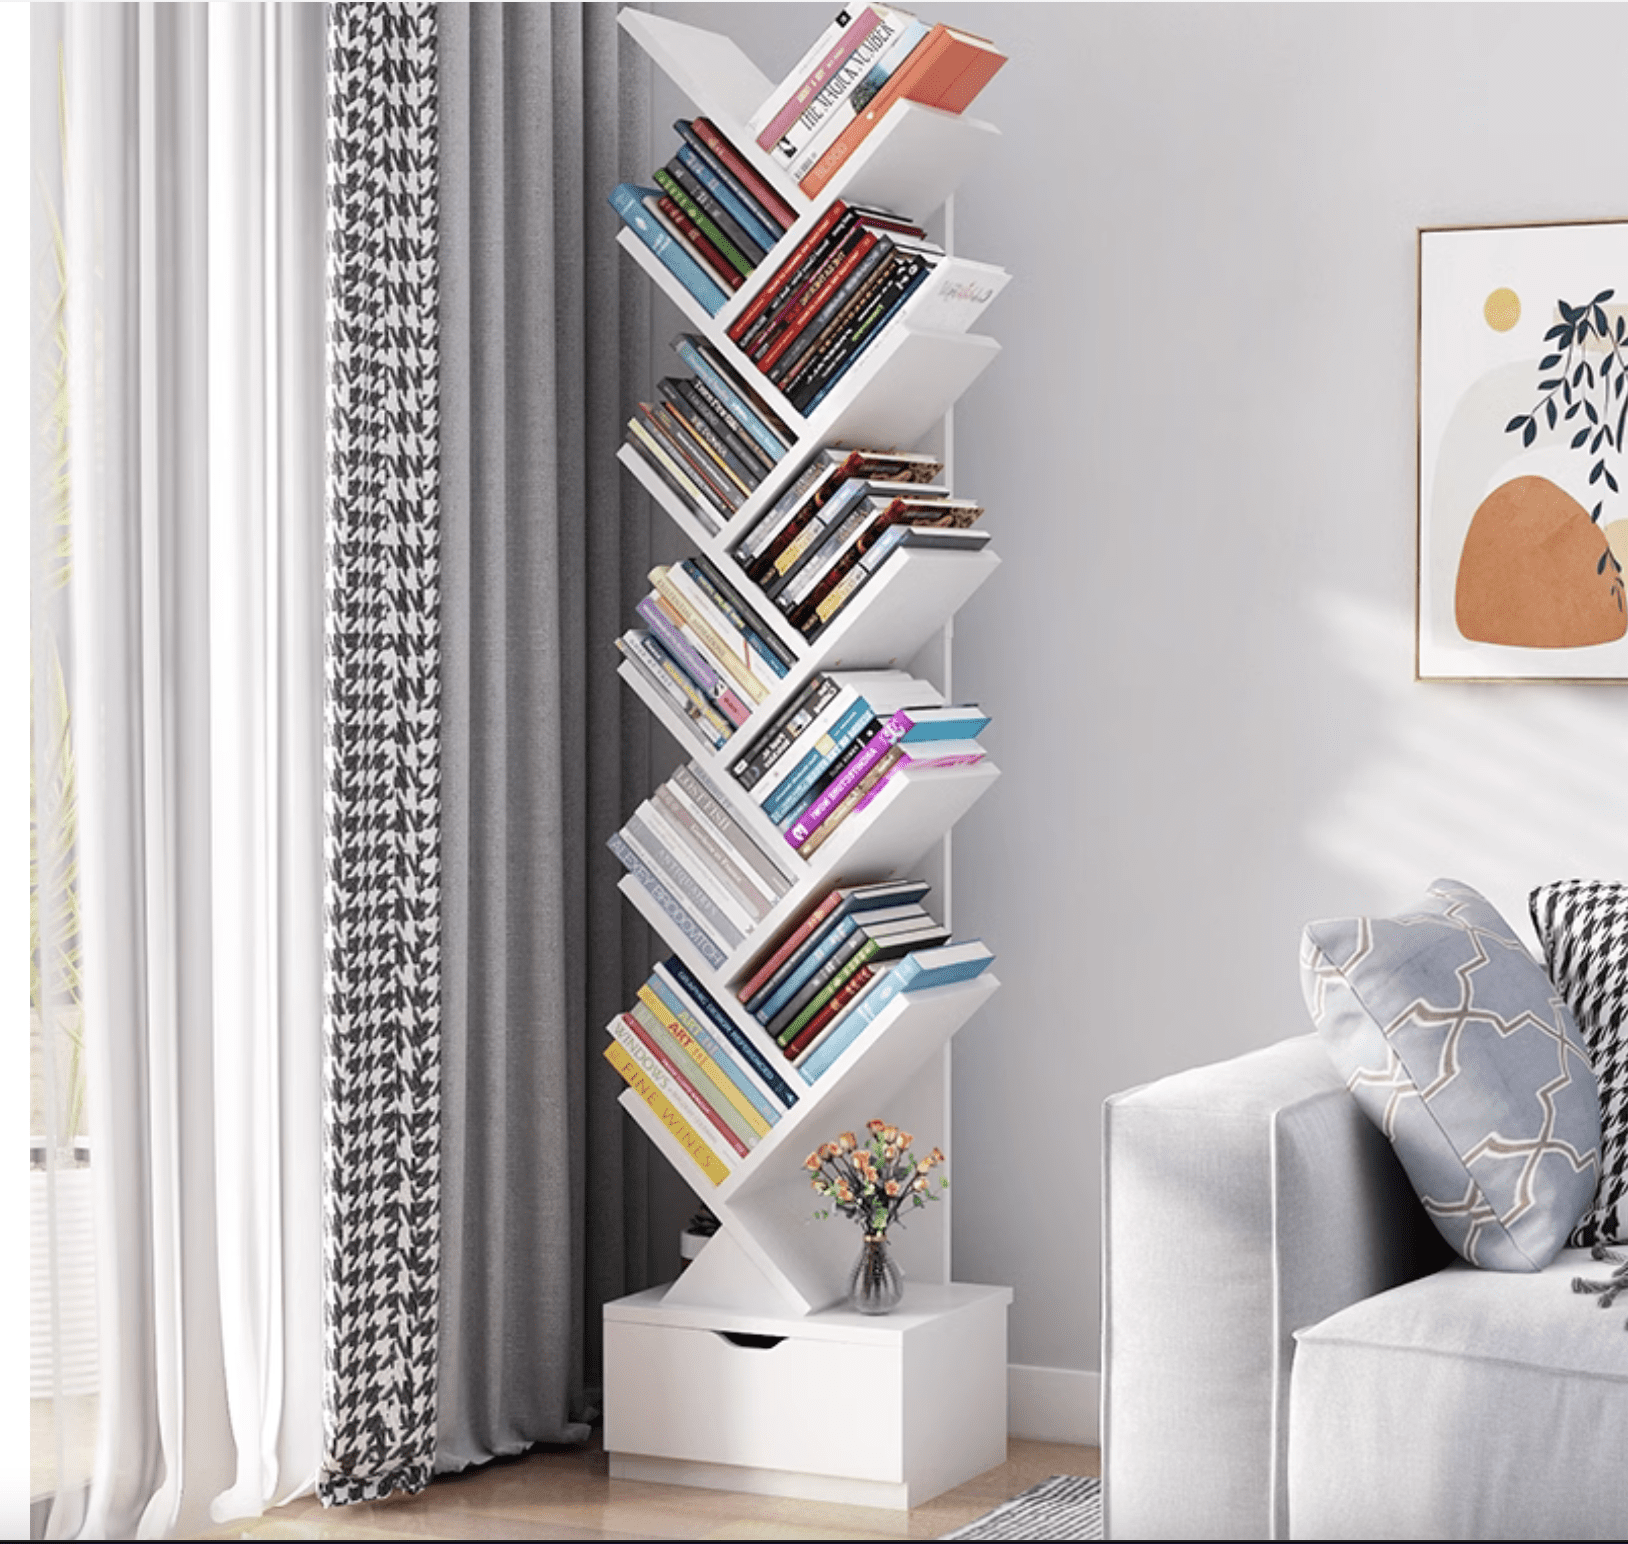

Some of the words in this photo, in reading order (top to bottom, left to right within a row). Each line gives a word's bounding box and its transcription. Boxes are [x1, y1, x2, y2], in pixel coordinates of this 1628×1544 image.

[797, 103, 824, 131] THE
[675, 770, 706, 804] LOST
[666, 1019, 694, 1049] ART
[676, 1009, 702, 1037] ART
[610, 1021, 671, 1089] WINDOWS
[620, 1061, 660, 1106] FINE
[659, 1106, 715, 1169] WINES
